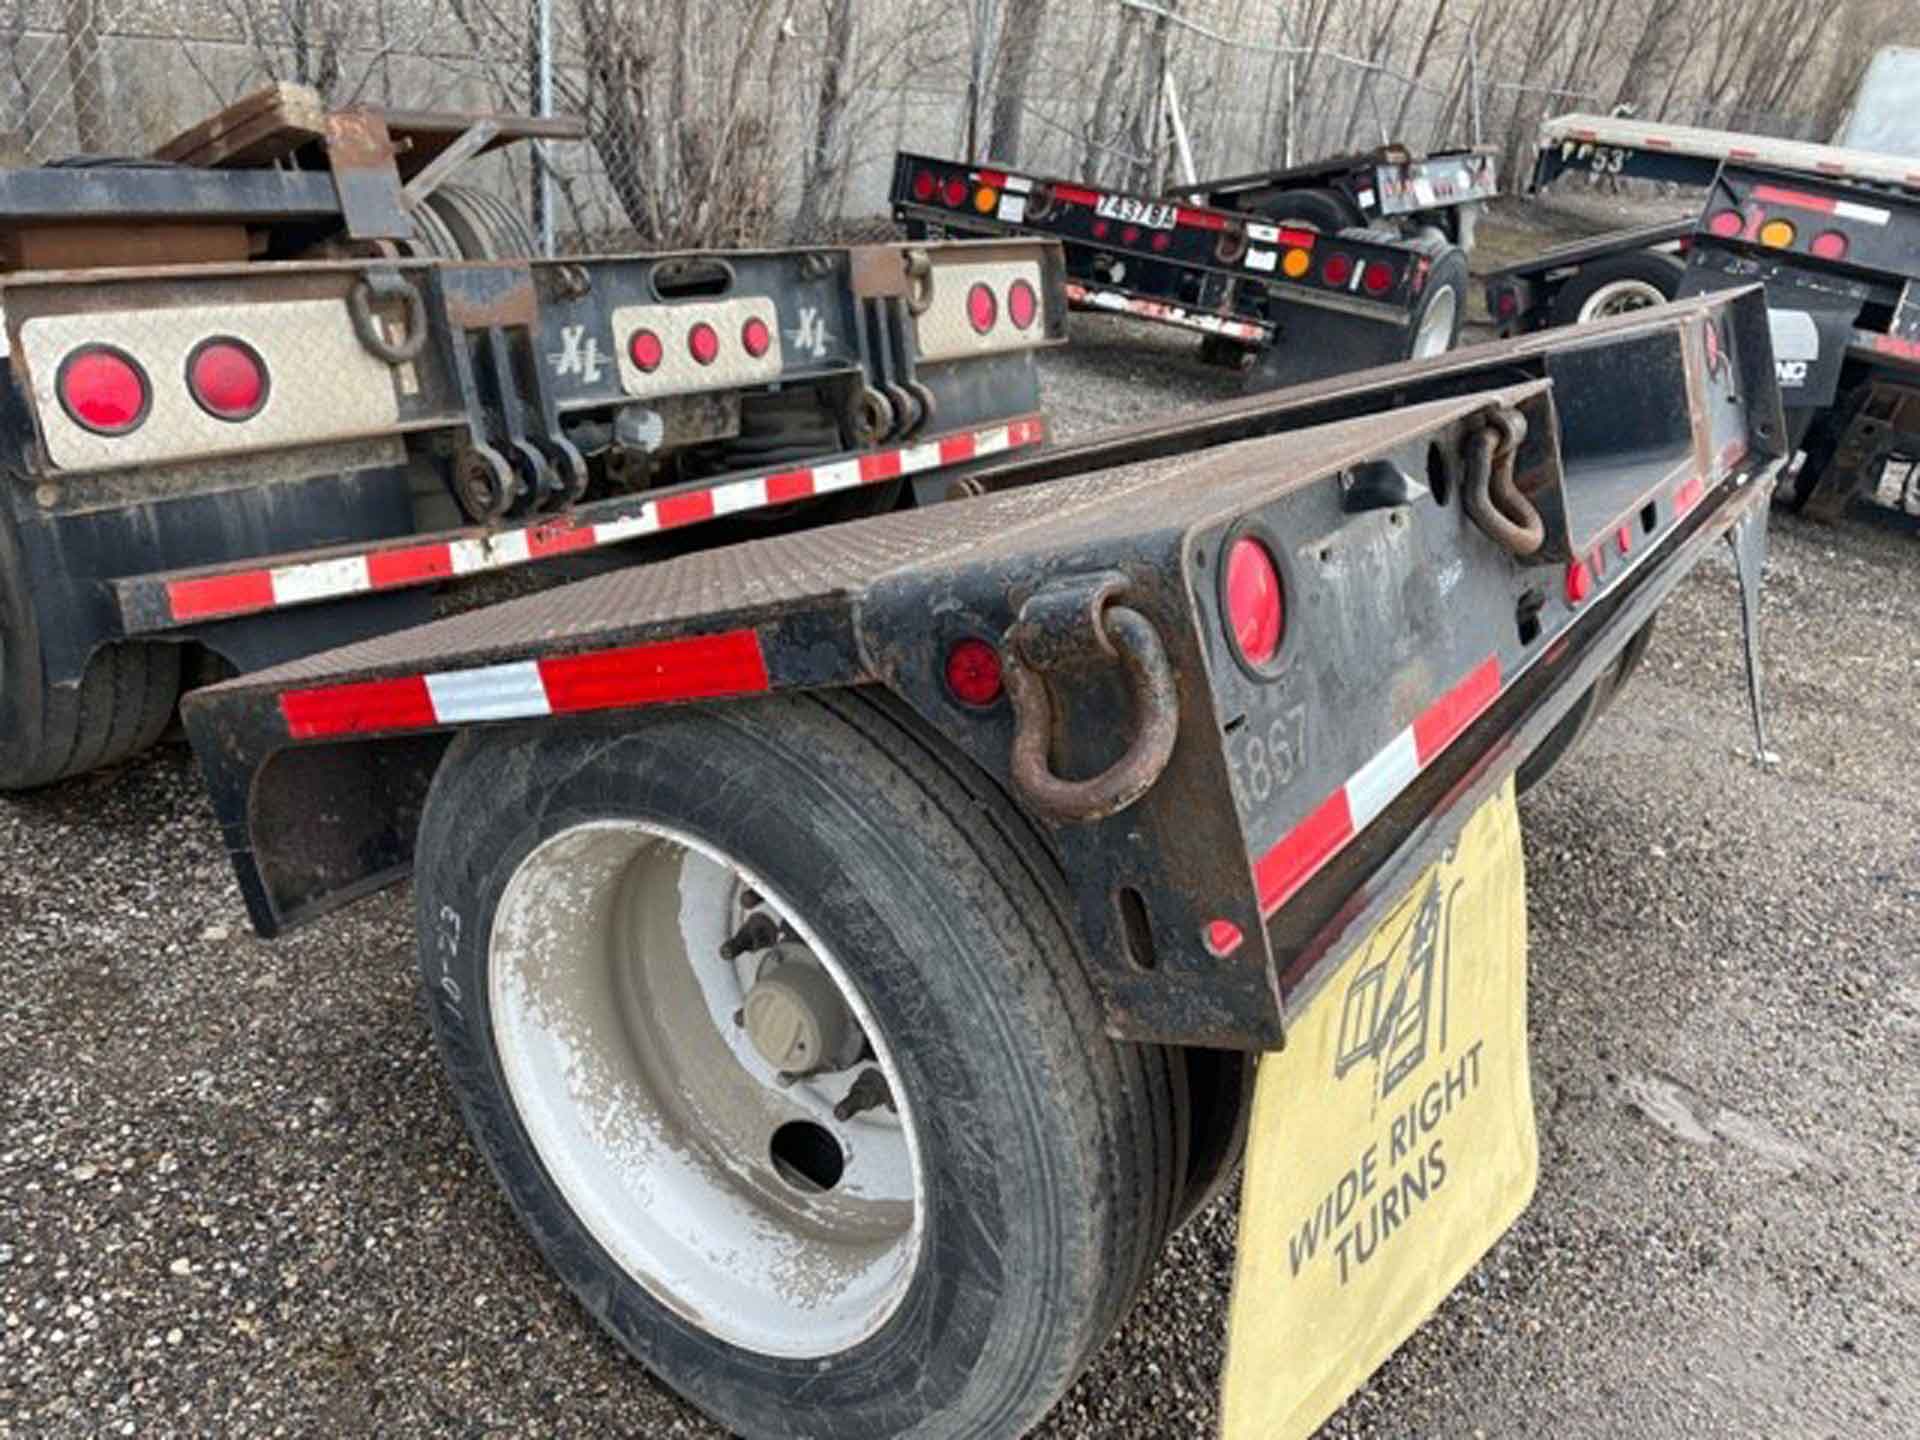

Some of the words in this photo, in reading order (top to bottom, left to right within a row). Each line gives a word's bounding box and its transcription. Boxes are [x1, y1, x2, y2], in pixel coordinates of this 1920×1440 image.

[555, 325, 601, 384] XL
[1288, 1143, 1378, 1278] WIDE
[1390, 1039, 1484, 1168] RIGHT
[1333, 1139, 1448, 1286] TURNS
